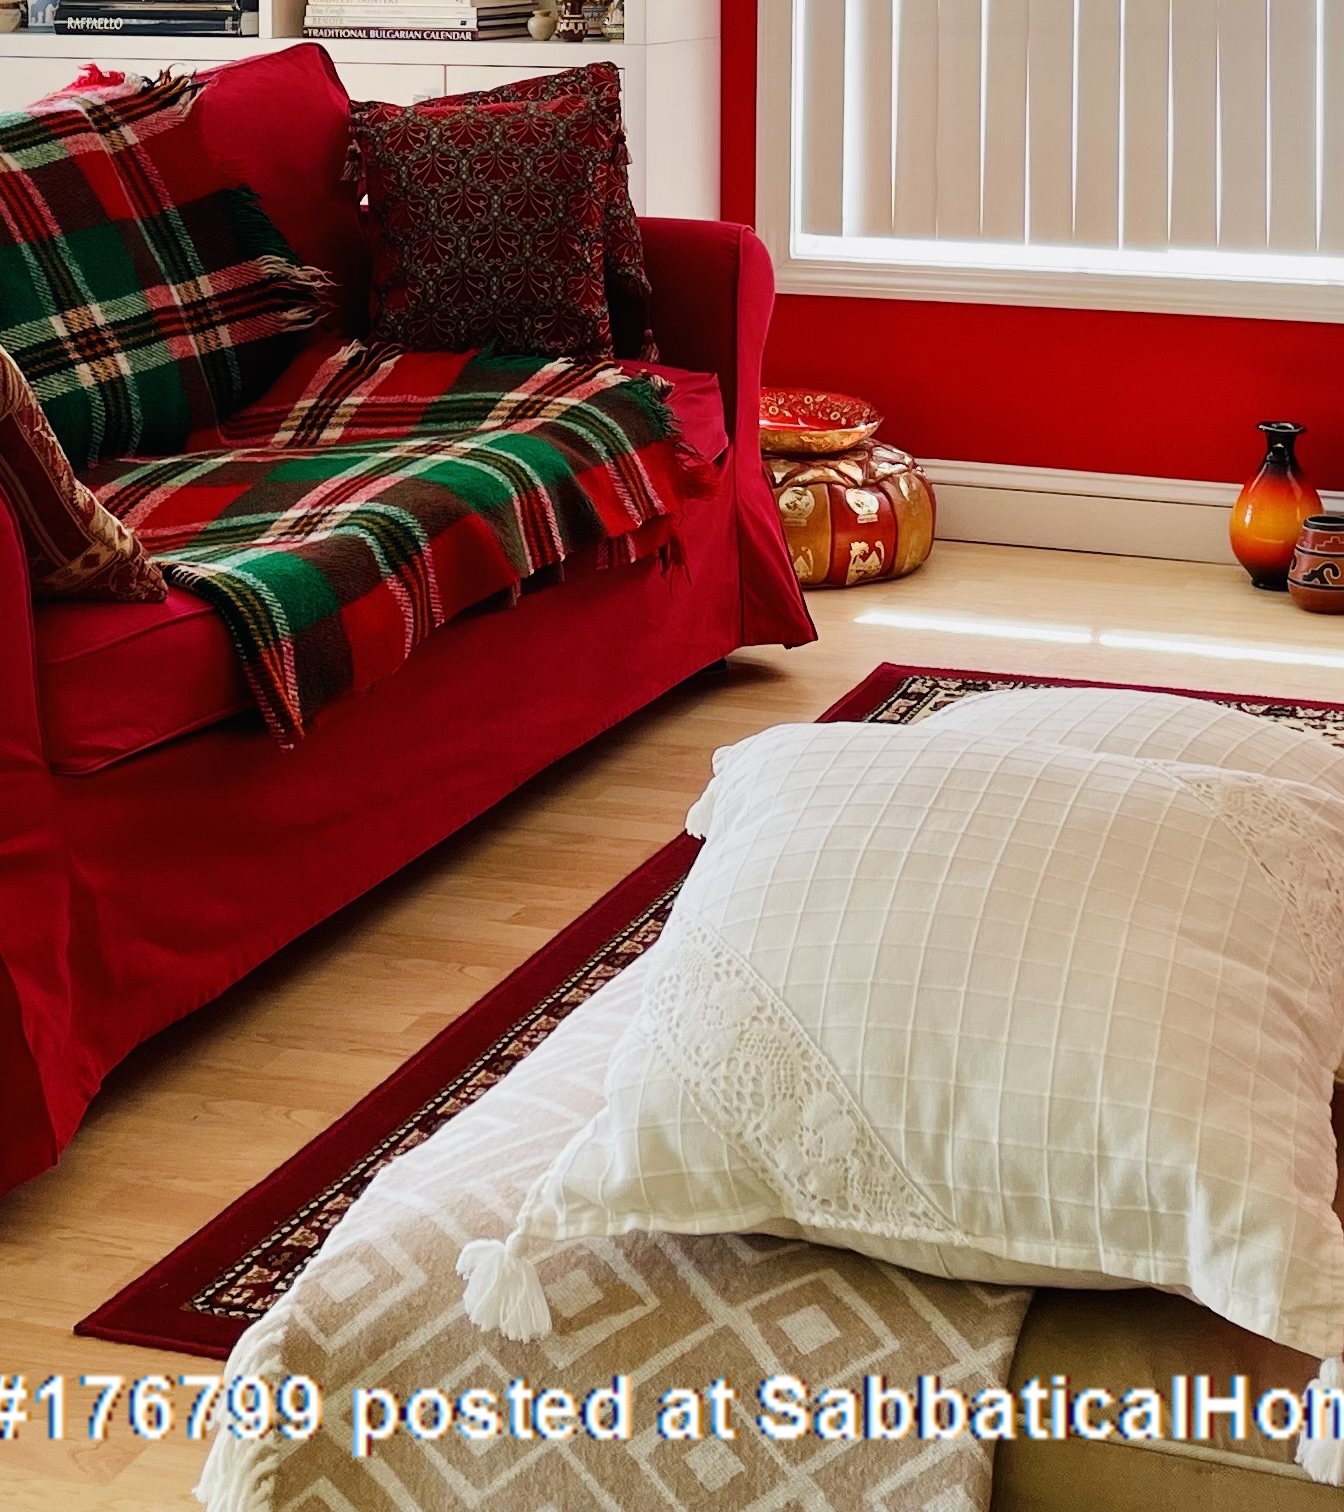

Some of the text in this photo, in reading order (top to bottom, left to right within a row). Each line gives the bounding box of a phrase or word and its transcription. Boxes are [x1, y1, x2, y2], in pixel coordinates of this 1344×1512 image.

[67, 17, 123, 30] RAFFAELLO
[307, 28, 472, 40] TRADITIONAL BULGARIAN CALENDAR
